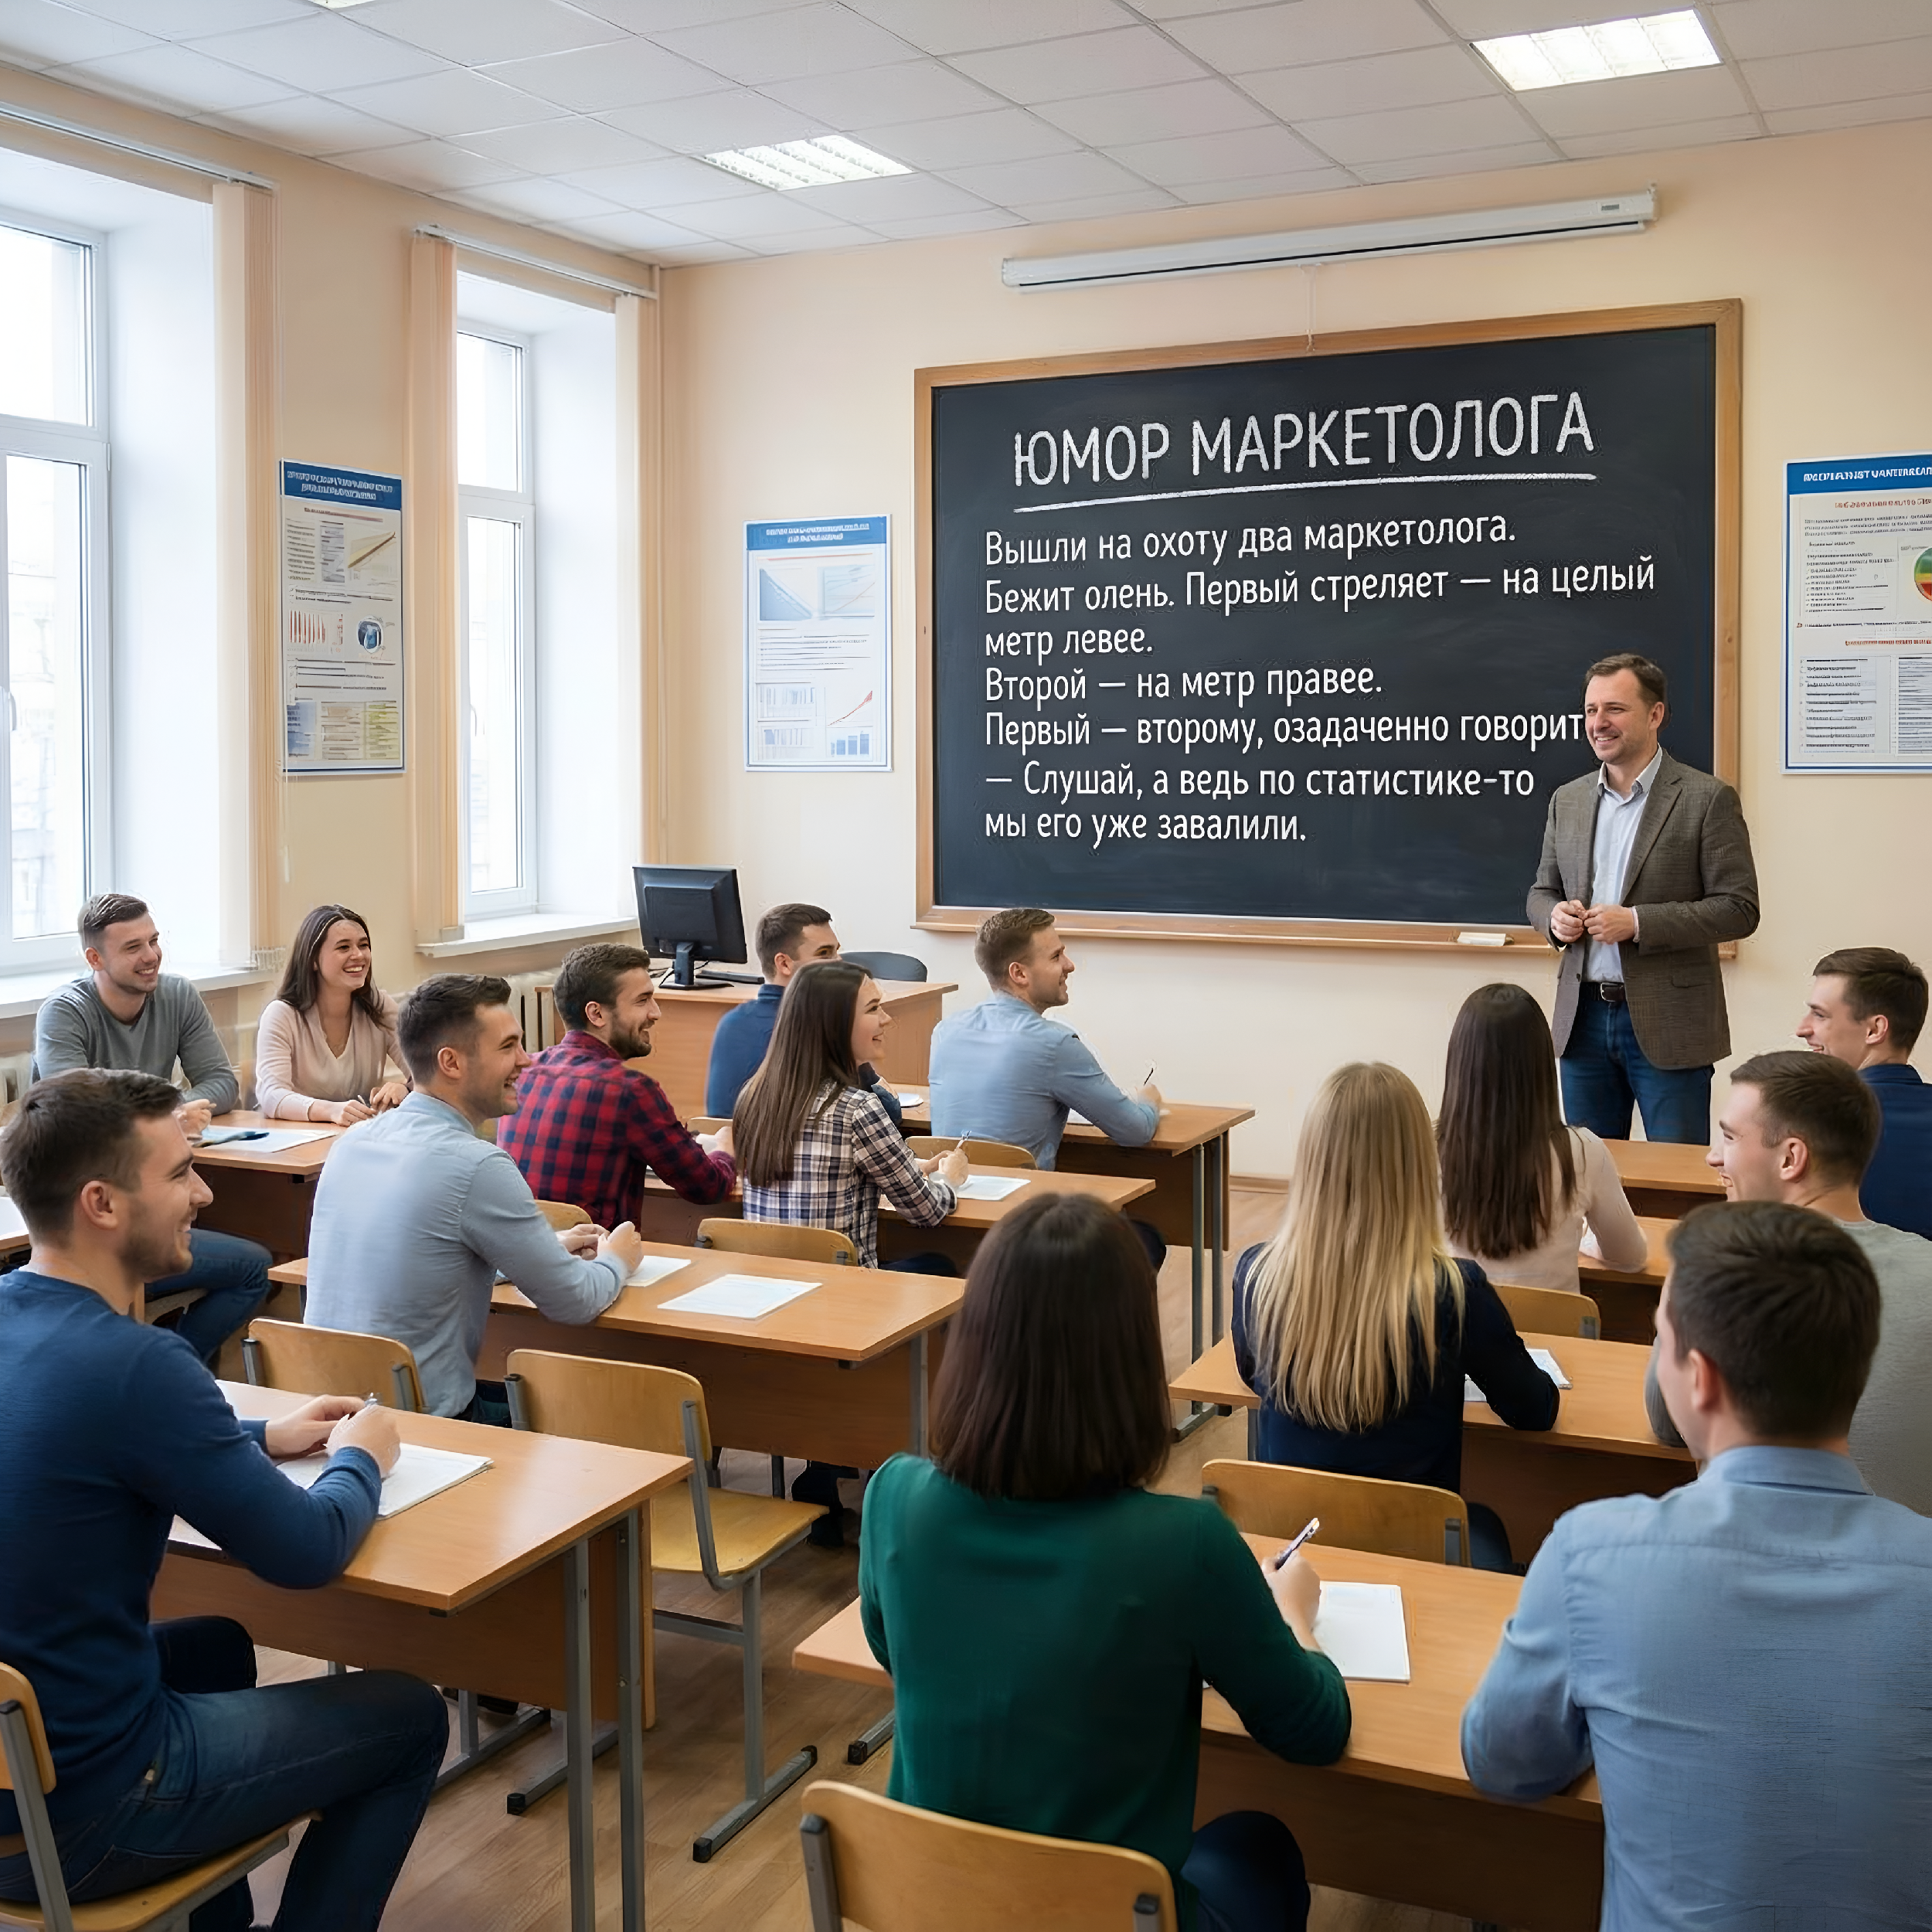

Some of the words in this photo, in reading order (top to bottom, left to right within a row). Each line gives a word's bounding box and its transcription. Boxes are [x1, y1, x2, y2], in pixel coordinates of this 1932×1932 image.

[1014, 422, 1170, 487] ЮМОР
[1191, 391, 1595, 476] МАРКЕТОЛОГА
[986, 531, 1087, 566] Вышли
[1099, 534, 1132, 560] на
[1143, 529, 1228, 566] охоту
[1238, 526, 1292, 559] два
[1304, 515, 1516, 560] маркетолога.
[986, 580, 1075, 614] Бежит
[1084, 583, 1175, 611] олень.
[1186, 570, 1299, 617] Первый
[1311, 571, 1449, 613] стреляет
[1503, 567, 1539, 594] на
[1552, 554, 1655, 598] целый
[985, 631, 1053, 666] метр
[1062, 628, 1154, 657] левее.
[986, 667, 1086, 712] Второй
[1138, 672, 1170, 699] на
[1182, 670, 1255, 709] метр
[1267, 667, 1383, 707] правее.
[986, 712, 1090, 757] Первый
[1138, 716, 1264, 754] второму,
[1274, 716, 1449, 748] озадаченно
[1461, 714, 1583, 753] говорит
[1024, 760, 1143, 805] Слушай,
[1152, 770, 1169, 795] а
[1180, 770, 1250, 801] ведь
[1260, 770, 1295, 795] по
[1306, 760, 1535, 797] статистике-то
[985, 813, 1026, 837] мы
[1037, 813, 1082, 838] его
[1090, 814, 1147, 850] уже
[1157, 814, 1307, 842] завалили.
